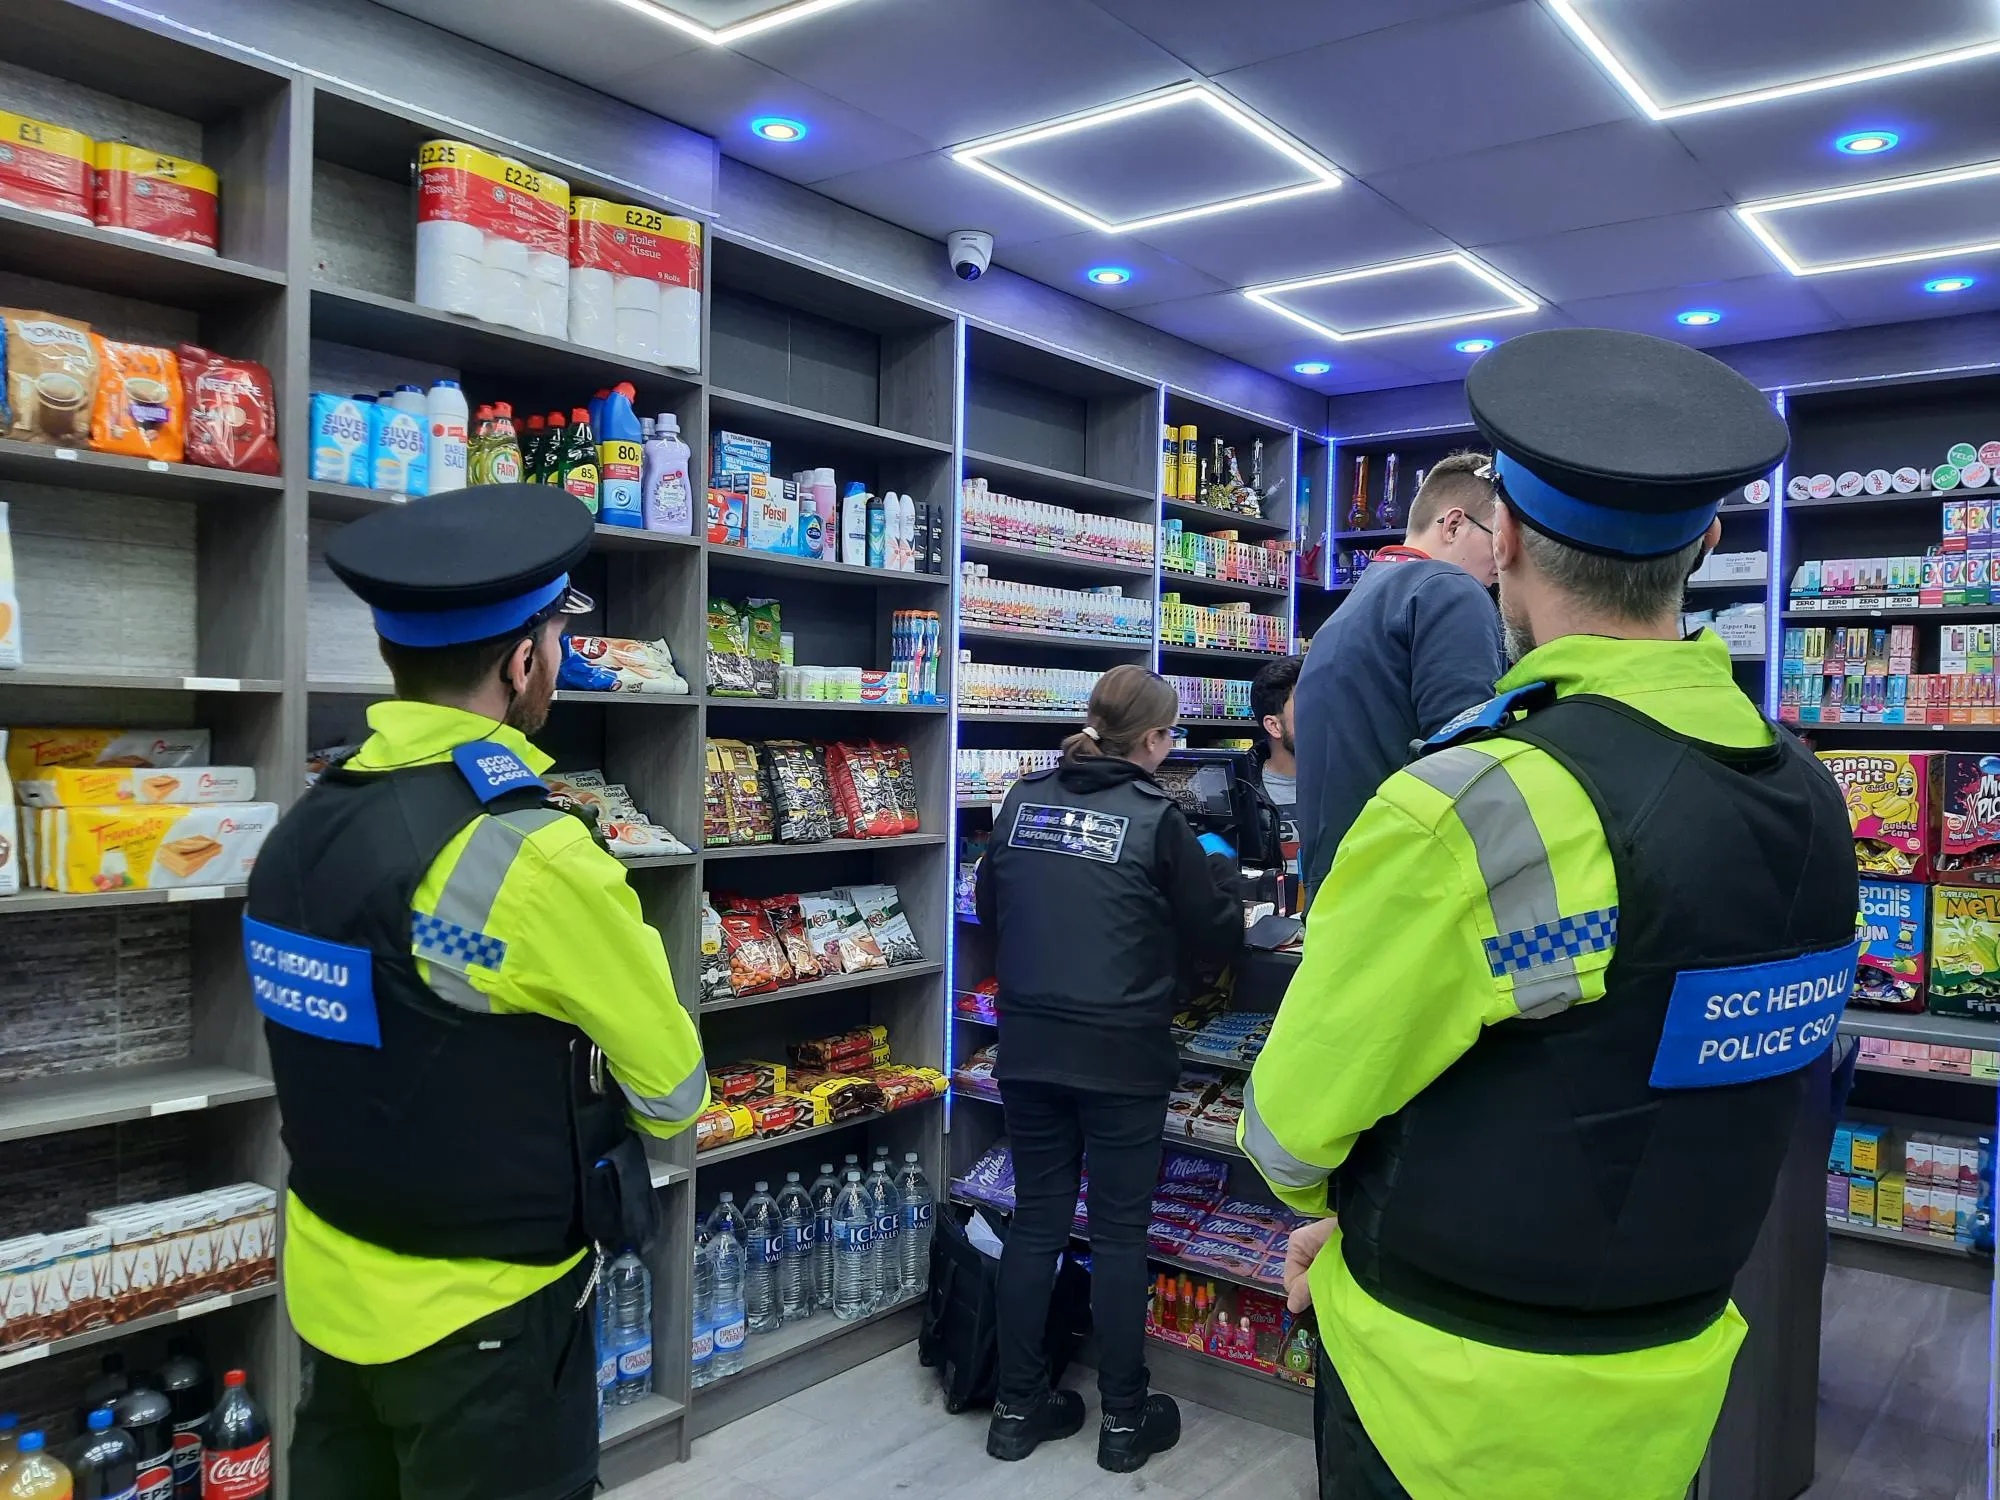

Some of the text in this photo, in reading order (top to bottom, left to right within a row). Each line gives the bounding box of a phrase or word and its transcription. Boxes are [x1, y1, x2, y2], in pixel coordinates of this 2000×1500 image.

[19, 123, 44, 145] £1
[421, 147, 456, 165] £2.25
[504, 167, 541, 193] £2.25
[508, 191, 534, 210] Toilet
[508, 204, 539, 225] Tissue
[625, 210, 662, 232] £2.25
[629, 233, 658, 248] Toilet
[629, 244, 662, 260] Tissue
[664, 273, 681, 284] Rolls
[324, 414, 369, 434] SILVER
[321, 425, 369, 445] SPOON
[381, 426, 425, 444] SILVER
[730, 434, 746, 442] TOUGH
[378, 437, 426, 455] SPOON
[618, 445, 640, 463] 80p
[723, 445, 768, 461] CONCENTRATED
[1951, 451, 1975, 462] VELO
[496, 462, 517, 477] FAIRY
[581, 467, 595, 480] 85p
[1935, 470, 1958, 485] VELO
[763, 503, 787, 523] Persil
[1721, 622, 1757, 632] Zipper Bag
[862, 672, 883, 681] Colgate
[861, 688, 884, 697] Colgate
[1019, 813, 1060, 825] TRADING
[1017, 829, 1062, 843] SAFONAU
[1858, 884, 1911, 902] ennis
[1861, 898, 1911, 918] balls
[250, 940, 349, 988] SCC HEDDLU
[253, 975, 348, 1023] POLICE CSO
[1703, 967, 1849, 1021] SCC HEDDLU
[1698, 1013, 1835, 1065] POLICE CSO
[979, 1154, 1007, 1186] Milka
[1170, 1157, 1212, 1177] Milka
[1161, 1183, 1204, 1196] Milka
[1226, 1201, 1273, 1215] Milka
[874, 1213, 899, 1233] ICE
[1206, 1219, 1253, 1234] Milka
[850, 1224, 876, 1243] ICE
